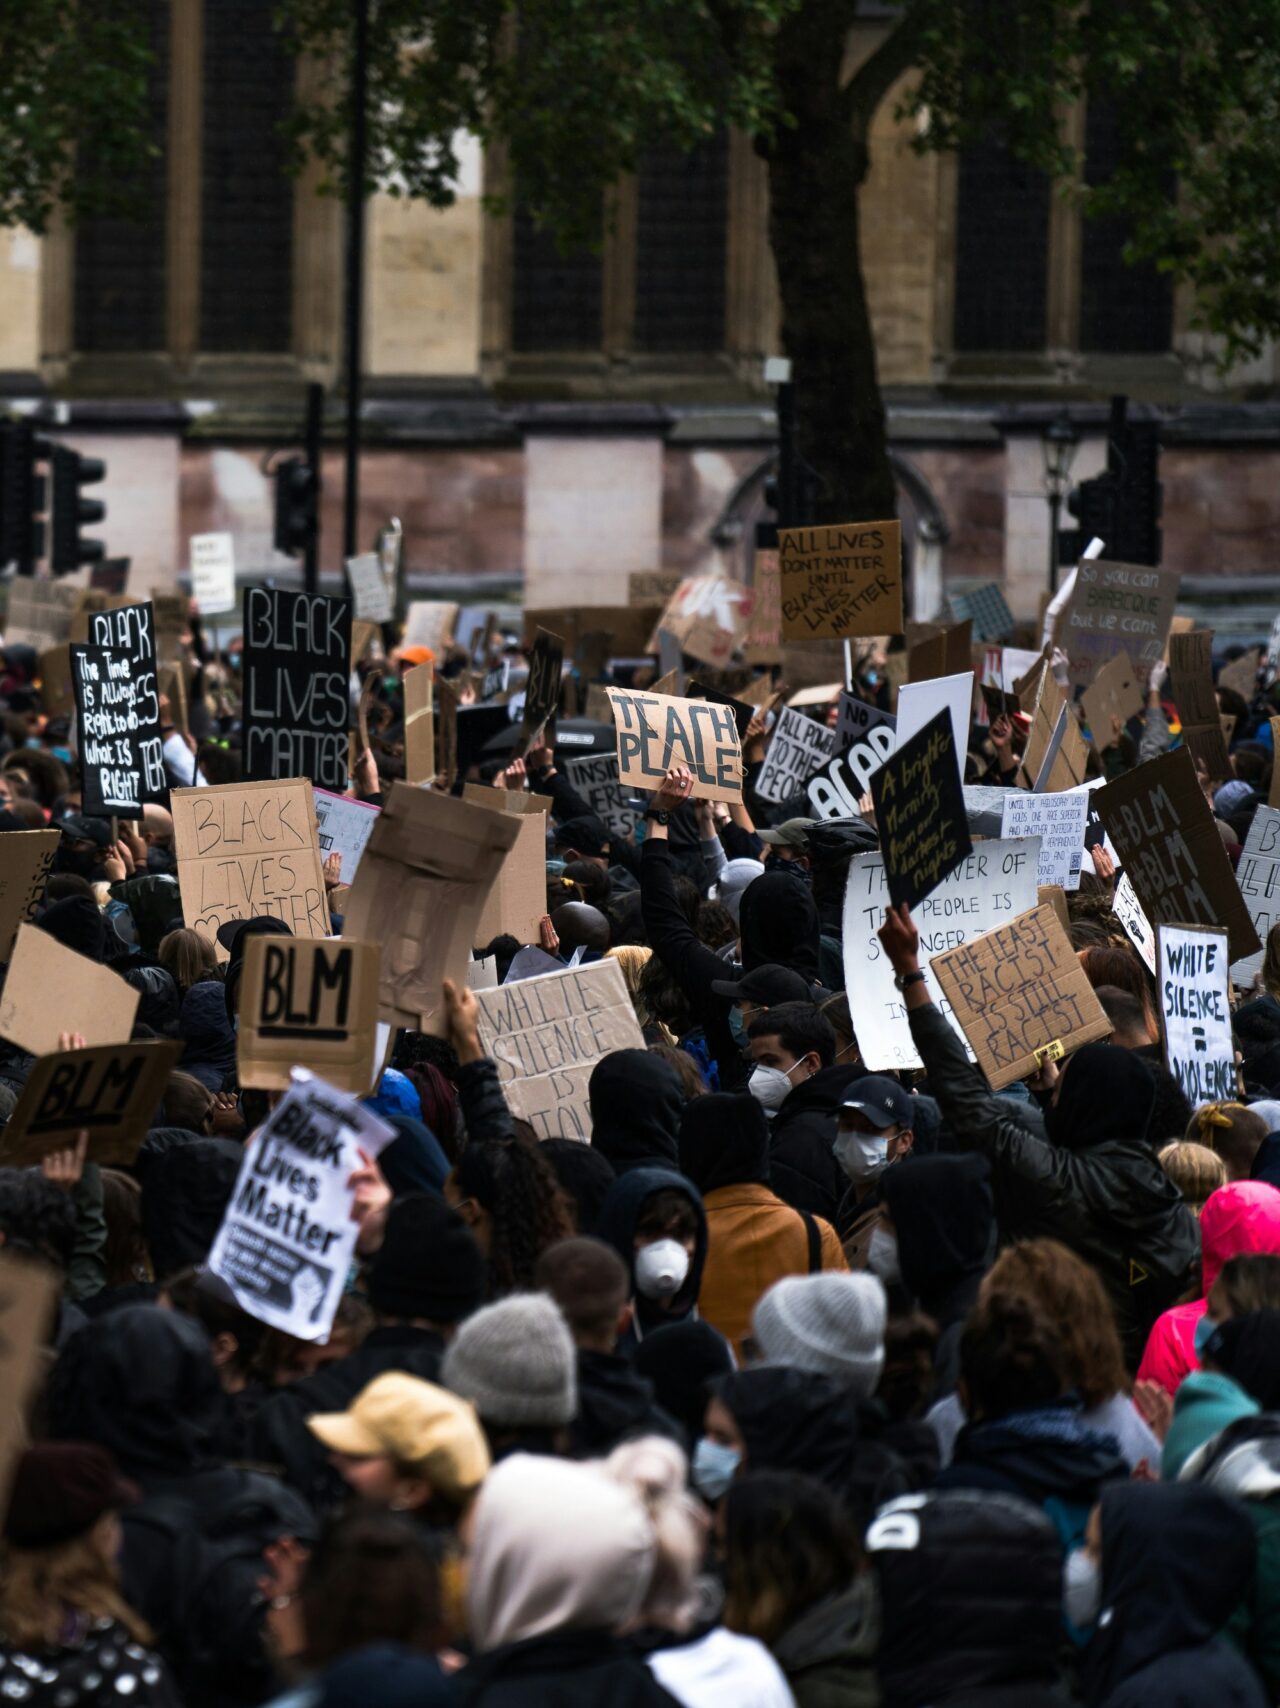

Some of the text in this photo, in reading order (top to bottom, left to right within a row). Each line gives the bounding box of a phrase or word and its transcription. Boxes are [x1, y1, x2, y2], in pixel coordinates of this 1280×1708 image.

[782, 530, 884, 555] ALL LIVES
[825, 556, 885, 569] MATTER
[808, 571, 854, 586] UNTIL
[1081, 566, 1159, 588] So you can
[249, 588, 346, 659] BLACK
[782, 585, 831, 621] BLACK
[803, 588, 850, 631] LIVES
[831, 574, 896, 634] MATTER
[1071, 610, 1094, 628] but
[1099, 614, 1118, 629] we
[77, 652, 130, 680] The Time
[83, 683, 95, 708] is
[250, 666, 347, 727] LIVES
[845, 702, 868, 726] NO
[83, 709, 138, 740] Right to do
[612, 695, 737, 770] TEACH
[779, 711, 802, 741] ALL
[85, 739, 132, 766] What IS
[247, 726, 349, 786] MATTER
[771, 736, 822, 776] TO THE
[100, 768, 140, 800] RIGHT
[881, 770, 895, 803] A
[1009, 800, 1024, 809] UNTIL
[1027, 799, 1036, 809] THE
[192, 797, 304, 855] BLACK
[1009, 822, 1081, 835] AND ANOTHER INFERIOR IS
[1012, 811, 1028, 822] HOLDS
[1032, 811, 1041, 821] ONE
[1047, 810, 1057, 820] RACE
[1060, 810, 1080, 820] SUPERIOR
[1108, 784, 1181, 853] #BLM
[200, 855, 296, 914] LIVES
[861, 864, 889, 895] TH
[1002, 853, 1027, 875] OF
[1130, 829, 1198, 900] #BLM
[922, 897, 980, 918] PEOPLE
[992, 892, 1012, 911] IS
[941, 912, 1050, 983] THE LEAST
[1166, 942, 1217, 978] WHITE
[261, 945, 353, 1026] BLM
[958, 939, 1057, 1010] RACIST
[479, 969, 600, 1035] WHITE
[976, 973, 1068, 1038] IS STILL
[1165, 980, 1225, 1023] SILENCE
[492, 1010, 612, 1084] SILENCE
[986, 993, 1083, 1070] RACIST
[35, 1056, 147, 1121] BLM
[548, 1071, 574, 1100] IS
[1173, 1056, 1238, 1106] VIOLENCE
[271, 1102, 346, 1168] Black
[254, 1137, 319, 1202] Lives
[235, 1177, 345, 1255] Matter
